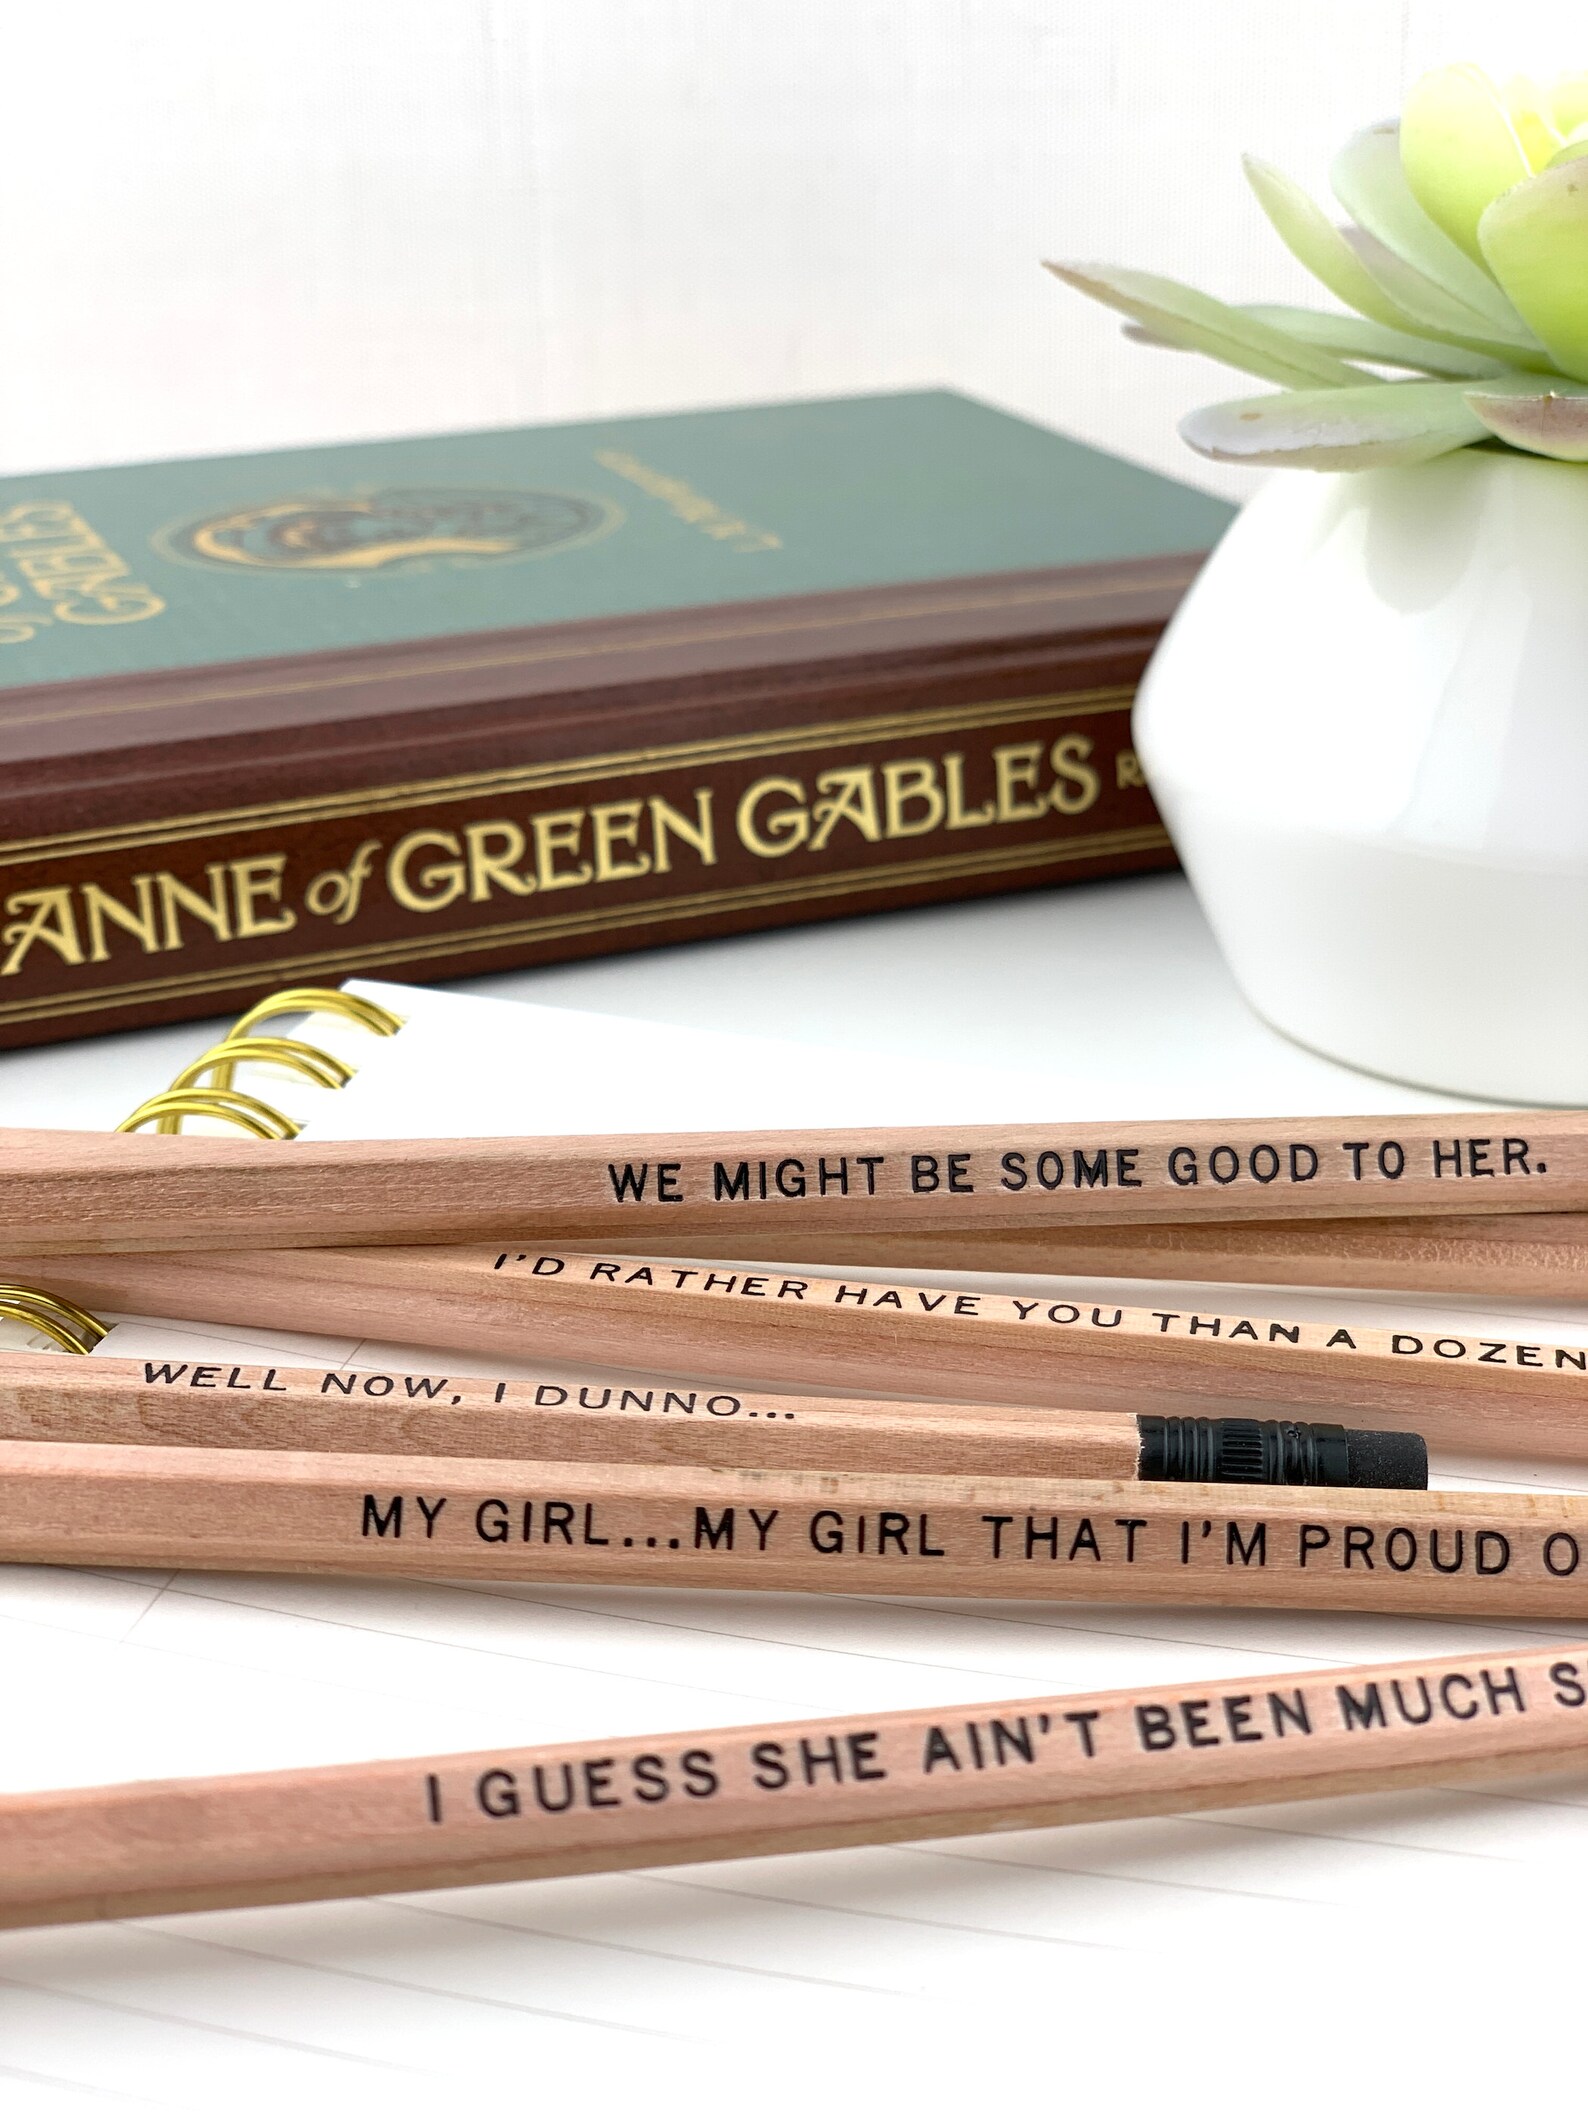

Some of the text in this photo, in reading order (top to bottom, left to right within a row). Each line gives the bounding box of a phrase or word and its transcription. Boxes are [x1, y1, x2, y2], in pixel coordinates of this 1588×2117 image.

[1, 854, 297, 976] ANNE
[306, 841, 384, 925] of
[387, 790, 720, 914] GREEN
[735, 733, 1099, 859] GABLES
[607, 1137, 1547, 1204] WE MIGHT BE SOME GOOD TO HER.
[492, 1253, 1587, 1371] I'D RATHER HAVE YOU THAN A DOZEN
[144, 1362, 795, 1420] WELL NOW, I DUNNO...
[361, 1493, 448, 1539] MY
[808, 1509, 946, 1557] GIRL
[980, 1515, 1149, 1564] THAT
[1180, 1519, 1267, 1567] I'M
[1299, 1523, 1511, 1576] PROUD
[428, 1660, 1588, 1823] I GUESS SHE AIN'T BEEN MUCH S
